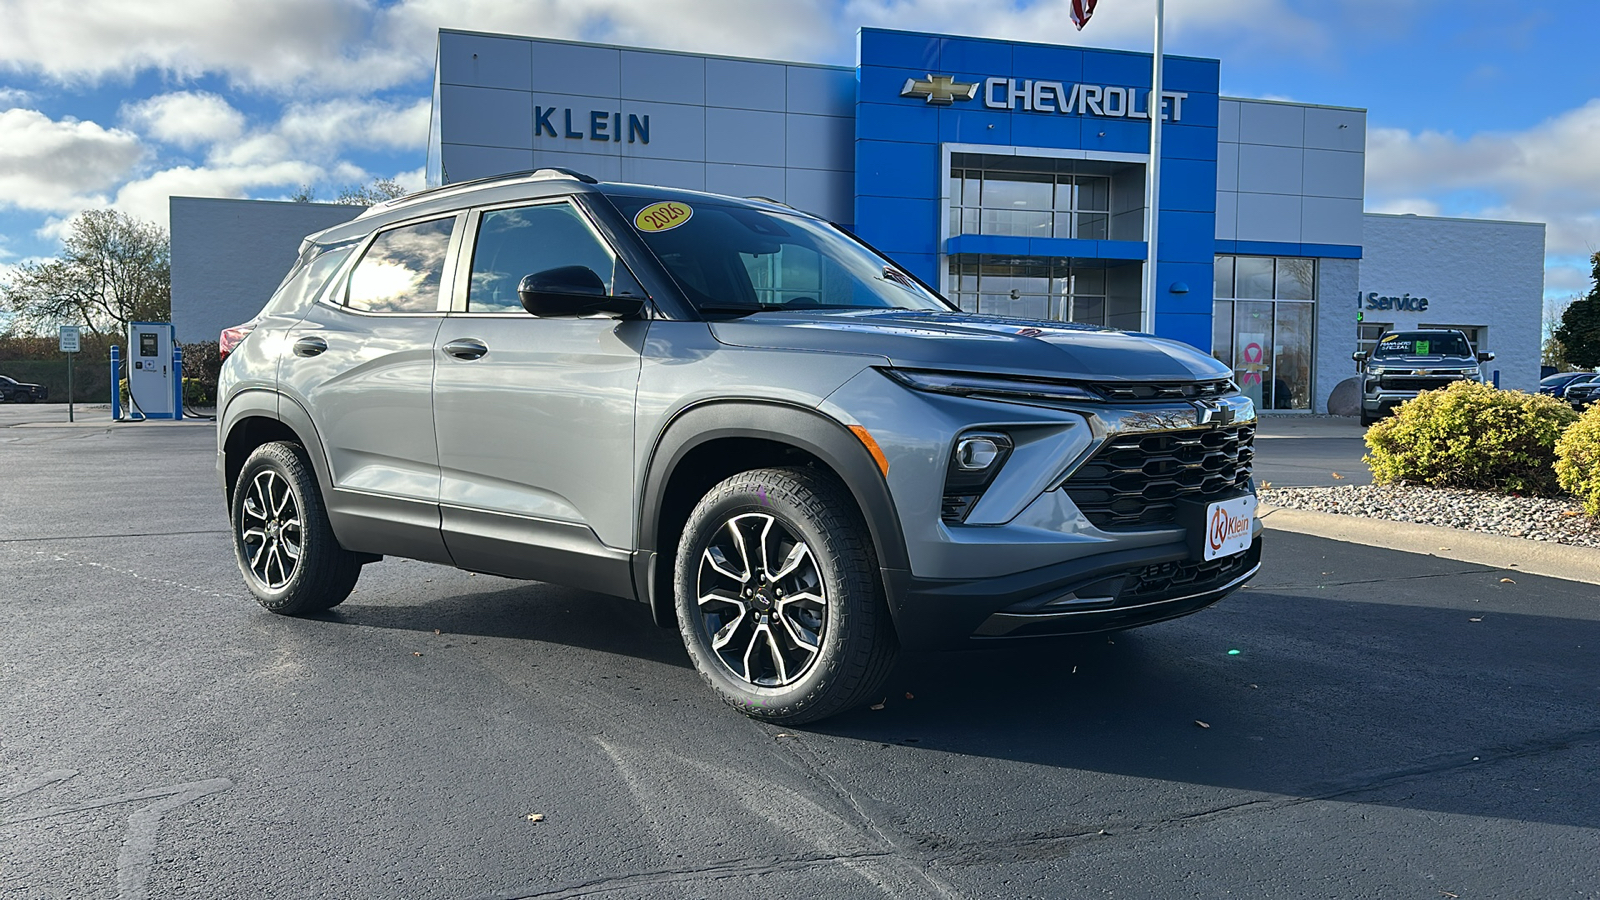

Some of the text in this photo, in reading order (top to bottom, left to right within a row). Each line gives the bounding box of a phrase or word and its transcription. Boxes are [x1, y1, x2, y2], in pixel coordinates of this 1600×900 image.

[535, 105, 650, 145] KLEIN
[643, 203, 685, 229] 2026
[1366, 292, 1429, 311] Service
[1227, 514, 1249, 535] Klein
